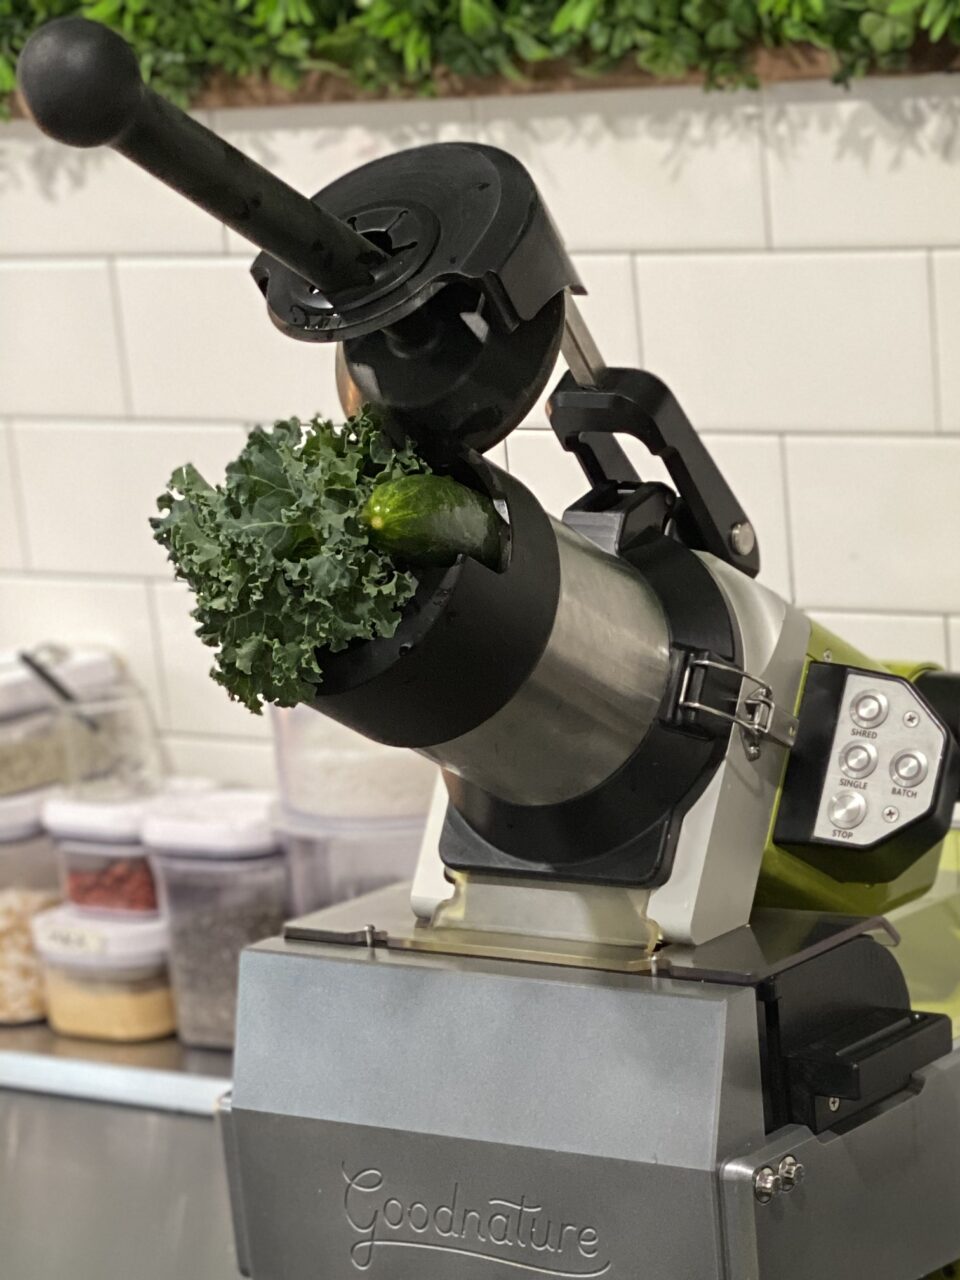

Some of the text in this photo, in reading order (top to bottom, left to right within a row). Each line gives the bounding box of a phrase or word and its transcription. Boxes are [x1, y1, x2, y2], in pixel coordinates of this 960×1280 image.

[850, 728, 878, 739] SHRED
[839, 778, 868, 790] SINGLE
[891, 787, 918, 799] BATCH
[832, 829, 853, 839] STOP
[341, 1161, 610, 1277] Goodnature
